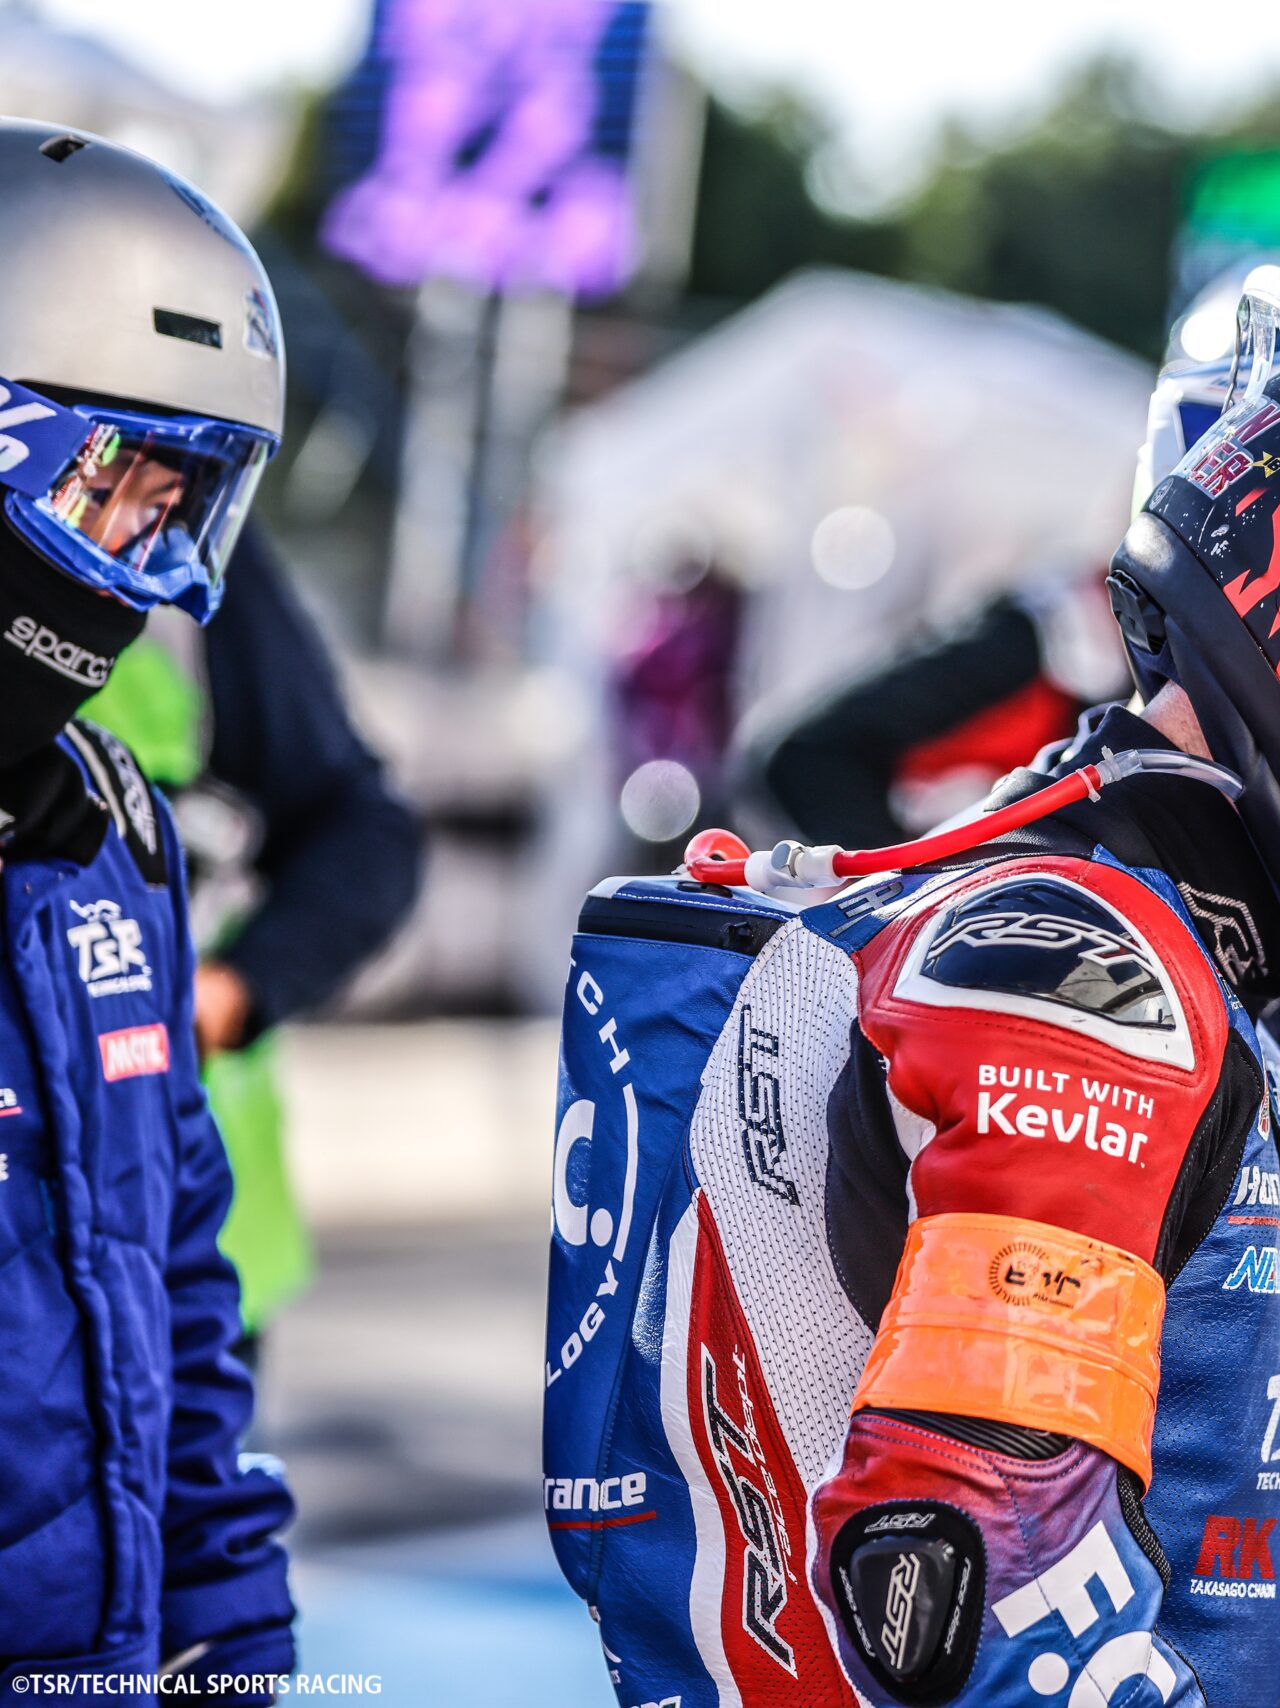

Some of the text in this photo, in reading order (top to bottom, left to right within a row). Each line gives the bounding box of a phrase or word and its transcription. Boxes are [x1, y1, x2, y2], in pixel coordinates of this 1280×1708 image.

[66, 918, 147, 983] TSR
[926, 911, 1160, 980] RST
[737, 1003, 801, 1207] RST
[978, 1064, 1155, 1119] BUILT WITH
[700, 1341, 799, 1680] RST
[764, 1464, 798, 1586] race
[1193, 1513, 1279, 1580] RK
[880, 1552, 921, 1670] RST
[1189, 1579, 1247, 1598] TAKASAGO
